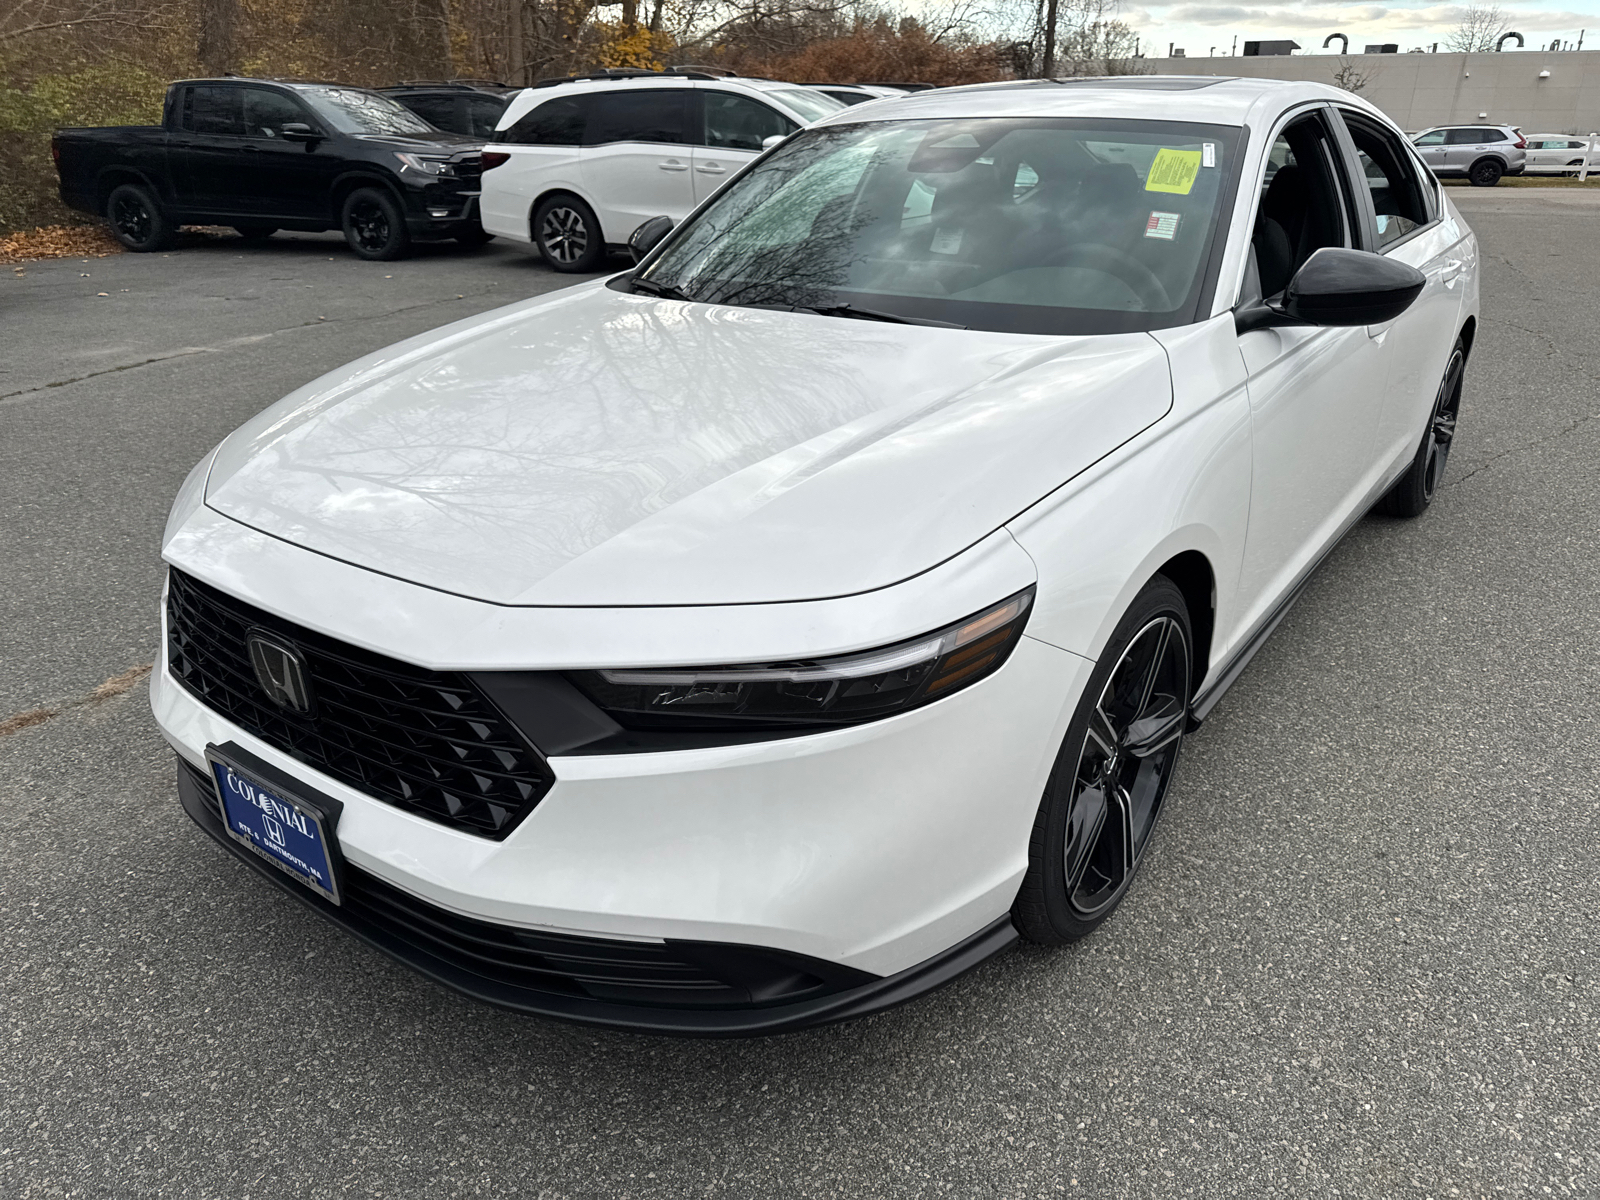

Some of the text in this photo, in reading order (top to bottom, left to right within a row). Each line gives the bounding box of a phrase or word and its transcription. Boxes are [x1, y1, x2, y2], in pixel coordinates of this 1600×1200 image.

[227, 773, 314, 840] COLONIAL
[251, 845, 285, 871] COLONIAL
[310, 866, 323, 881] MA
